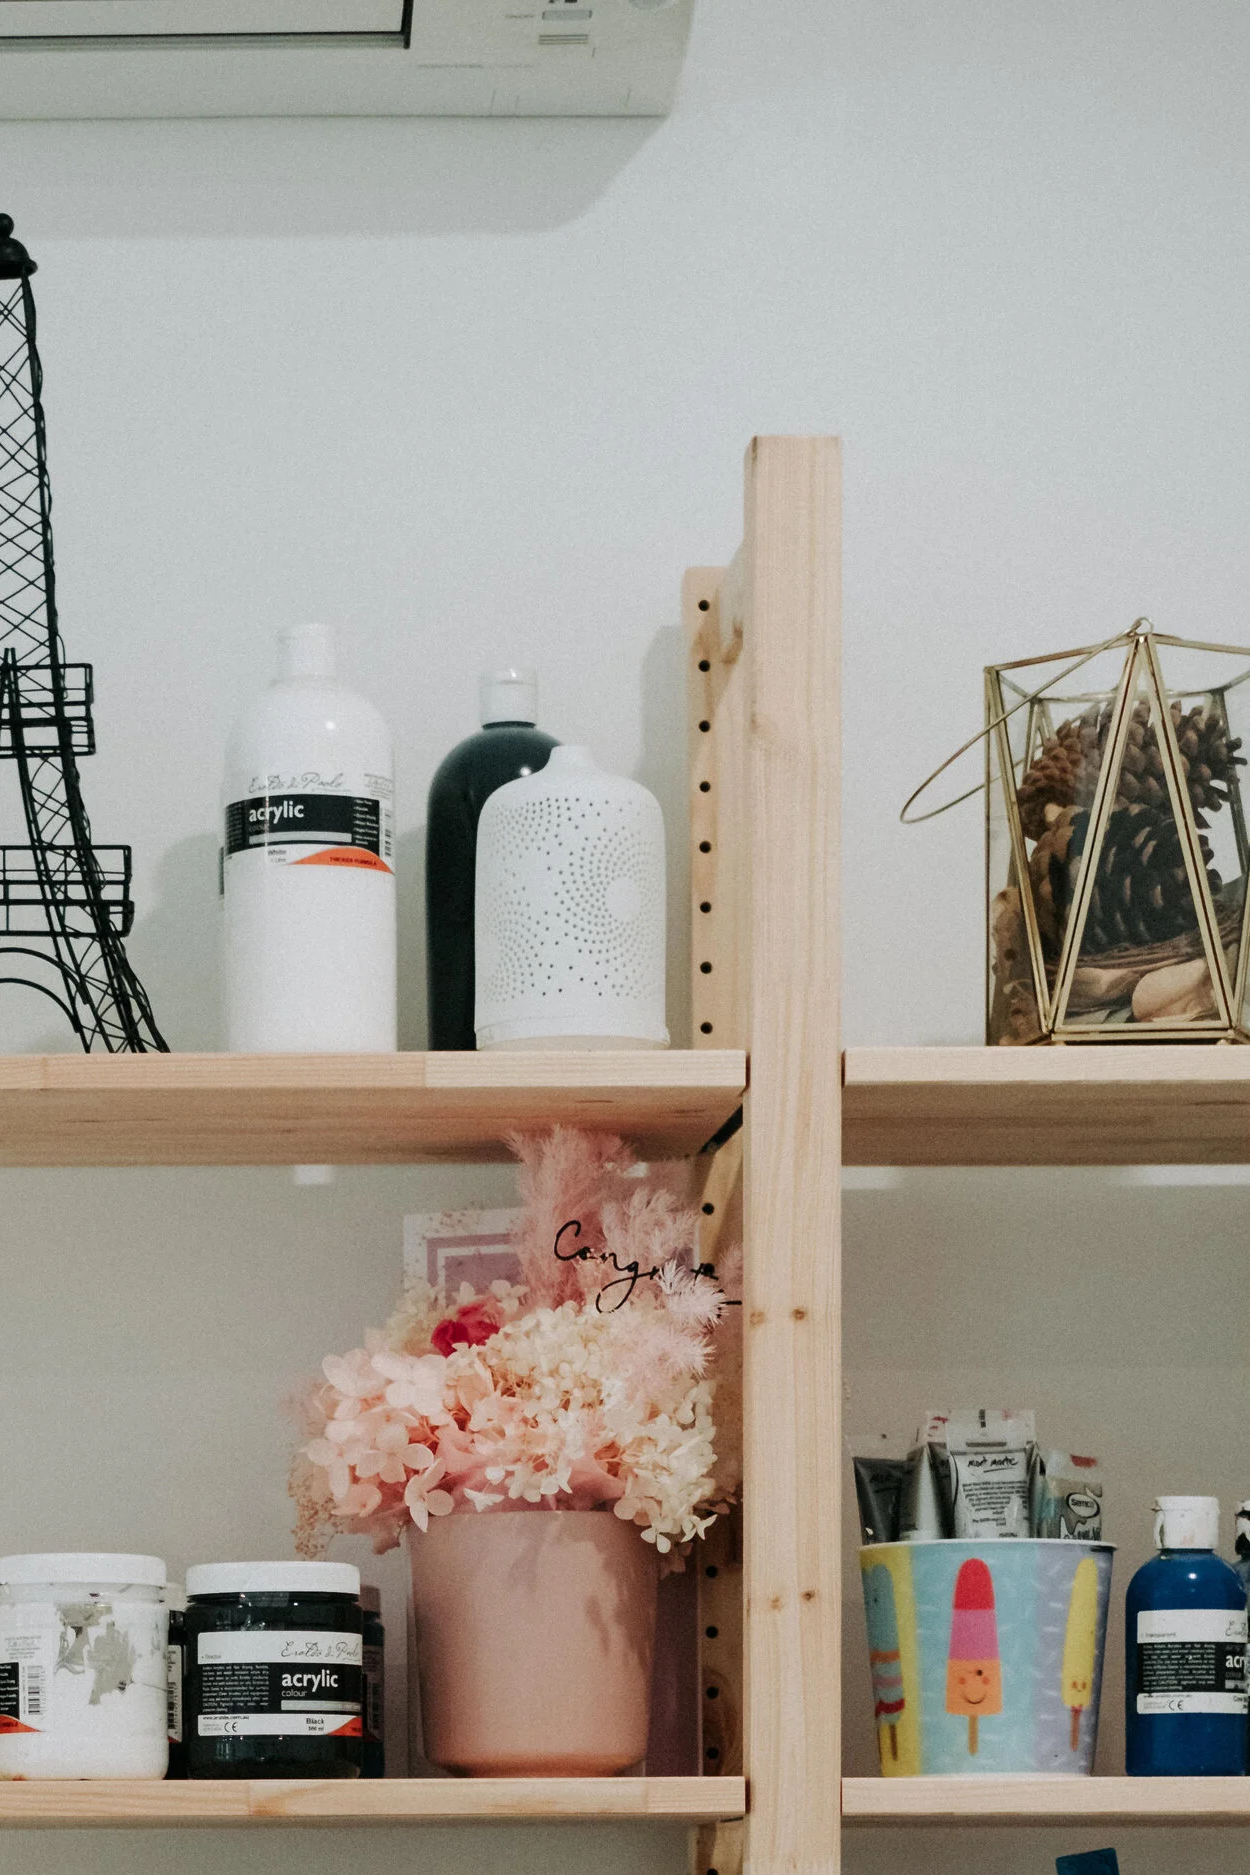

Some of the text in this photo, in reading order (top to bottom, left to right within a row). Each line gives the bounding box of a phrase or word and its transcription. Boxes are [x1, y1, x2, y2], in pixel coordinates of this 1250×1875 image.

[249, 800, 305, 824] acrylic
[281, 1669, 338, 1692] acrylic
[281, 1689, 307, 1697] colour
